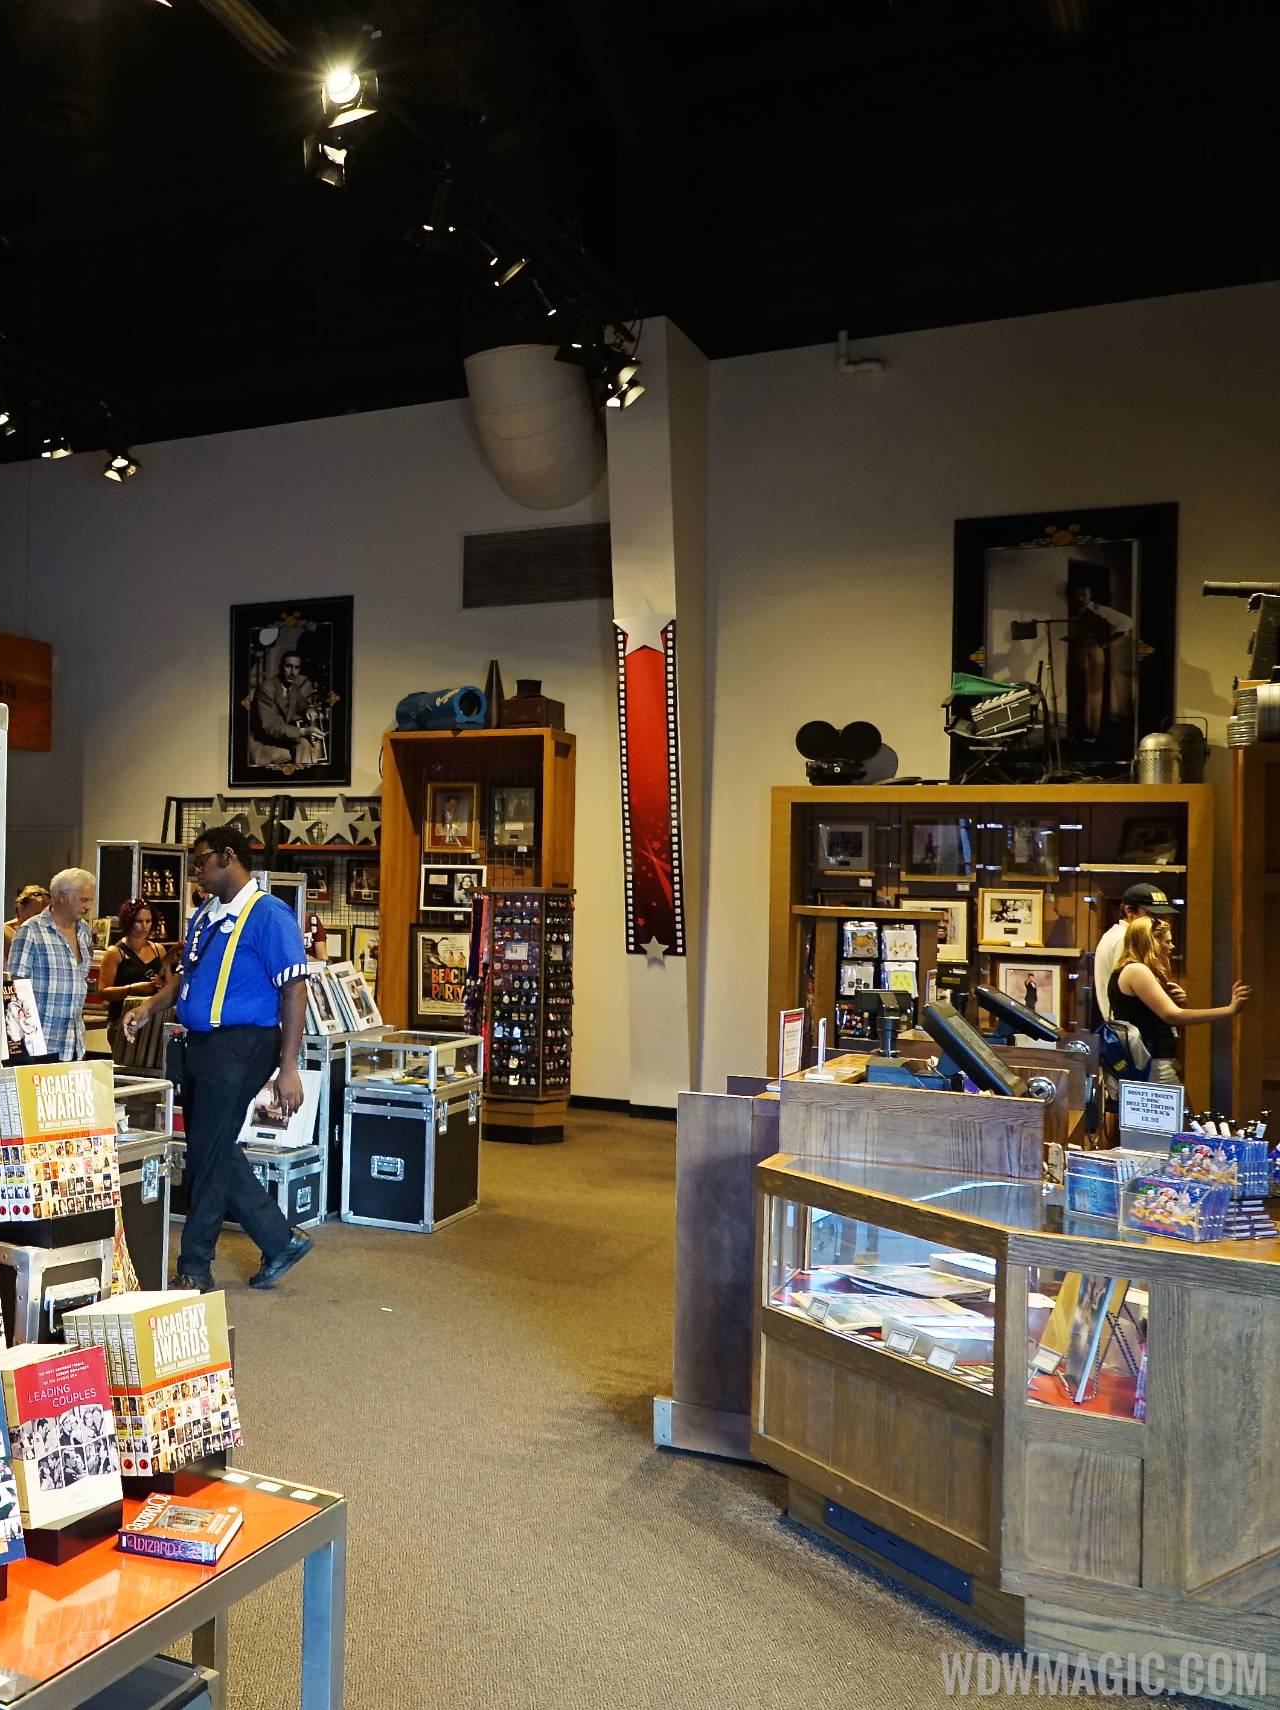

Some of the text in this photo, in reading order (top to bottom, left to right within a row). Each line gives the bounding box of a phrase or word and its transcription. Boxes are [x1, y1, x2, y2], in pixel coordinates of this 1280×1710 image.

[432, 968, 465, 983] BEACH
[432, 984, 464, 1003] PARTY
[41, 1072, 92, 1096] ACADEMY
[1151, 1092, 1173, 1100] FROZEN
[37, 1090, 94, 1122] AWARDS
[1130, 1107, 1170, 1116] SOUNDTRACK
[1151, 1103, 1174, 1111] EDITION
[157, 1306, 205, 1338] ACADEMY
[153, 1327, 209, 1368] AWARDS
[29, 1384, 70, 1403] LEADING
[52, 1388, 96, 1408] COUPLES
[134, 1536, 175, 1555] WIZARD
